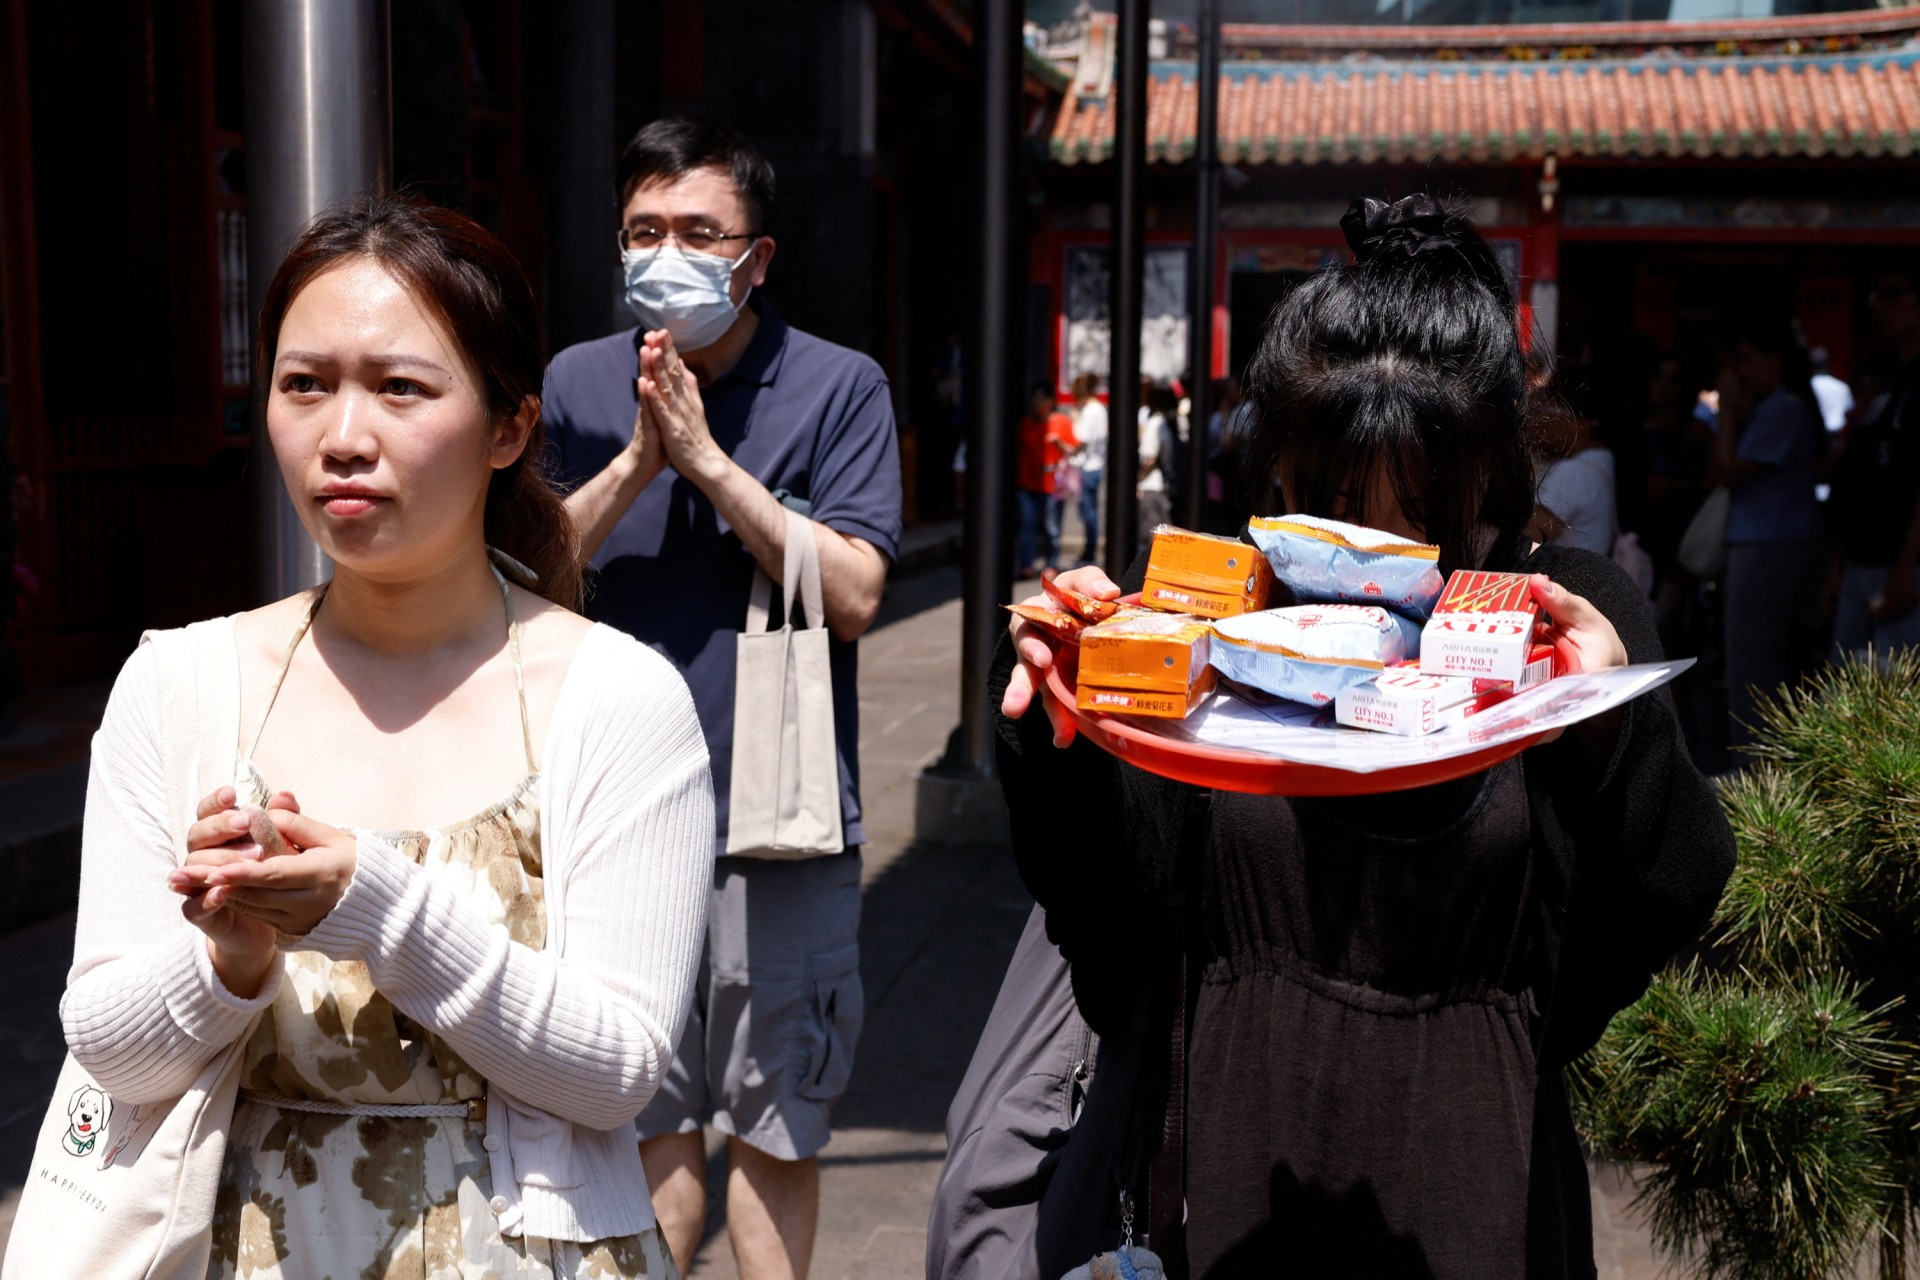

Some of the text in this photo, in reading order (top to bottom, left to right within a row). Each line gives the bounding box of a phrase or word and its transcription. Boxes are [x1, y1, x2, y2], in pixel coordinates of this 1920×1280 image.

[1442, 643, 1471, 653] ARITA
[1445, 655, 1467, 665] CITY
[1352, 694, 1375, 705] ARITA
[1354, 706, 1372, 717] CITY
[1422, 699, 1431, 733] CITY
